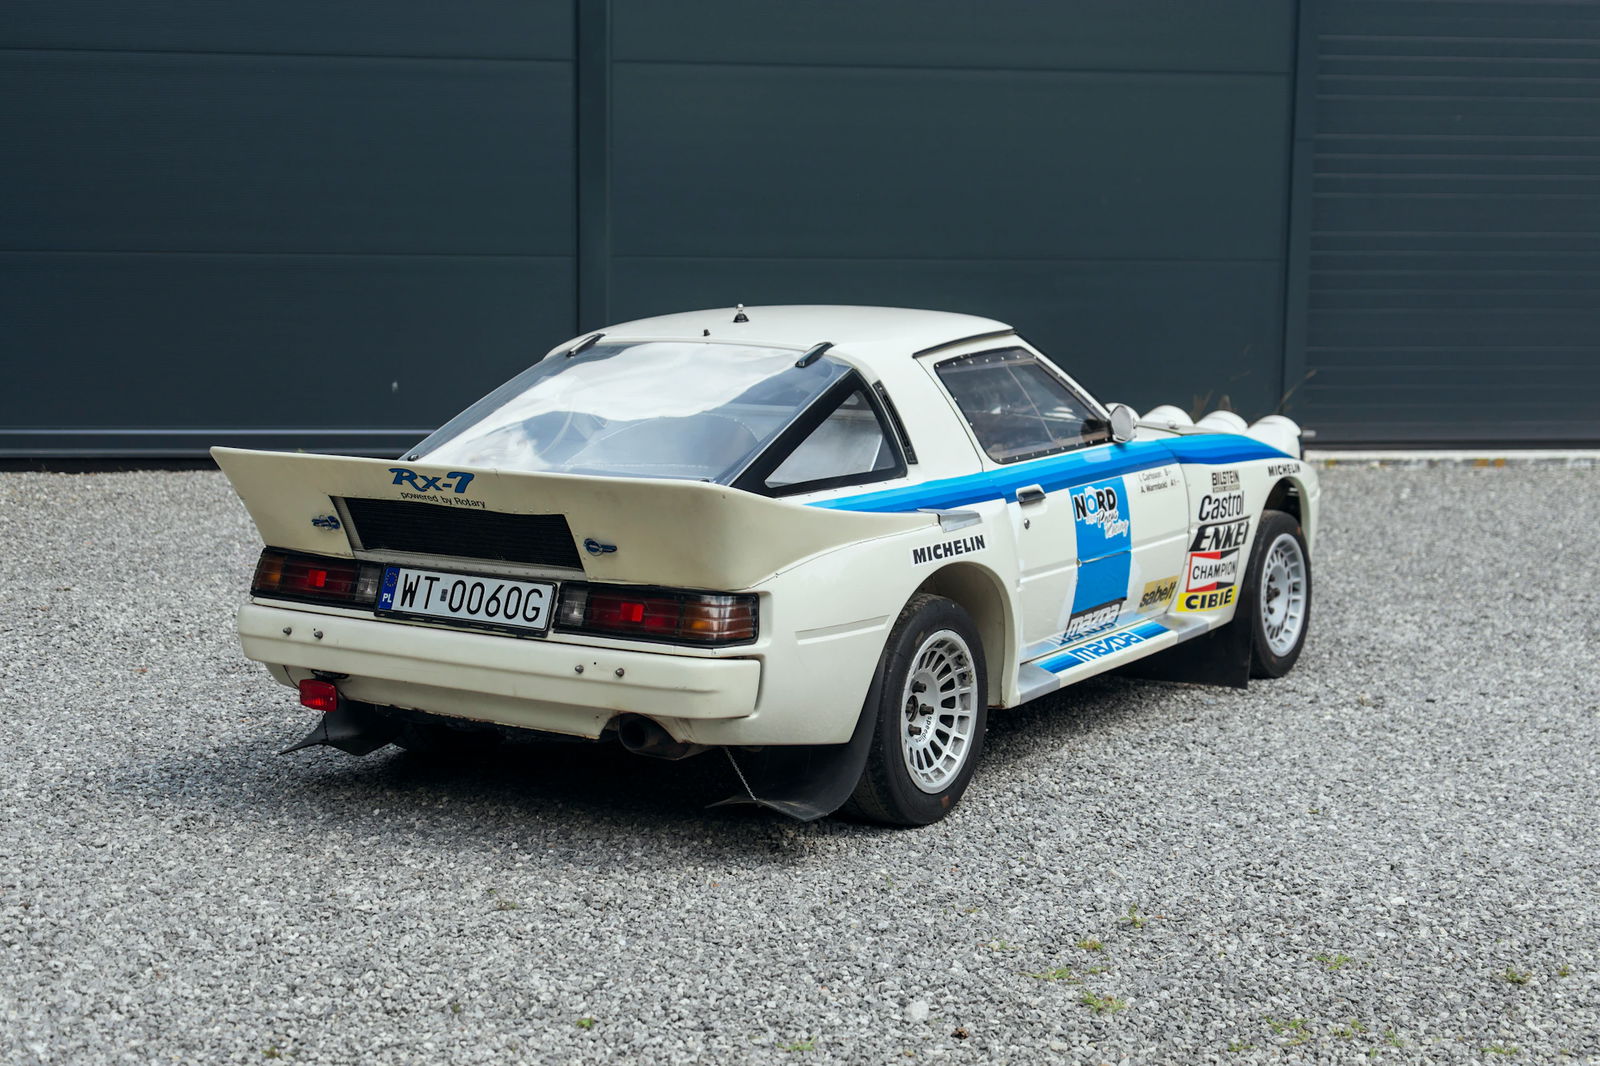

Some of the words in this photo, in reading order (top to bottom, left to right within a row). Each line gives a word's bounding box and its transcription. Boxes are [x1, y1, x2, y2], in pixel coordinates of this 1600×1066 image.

[1211, 469, 1240, 486] BILSTEIN
[1267, 463, 1301, 477] MICHELIN
[400, 492, 439, 503] powered
[440, 496, 452, 506] by
[453, 497, 486, 509] Rotary
[1073, 487, 1117, 519] NORD
[1198, 490, 1245, 522] Castrol
[1188, 519, 1250, 552] ENKEI
[912, 534, 986, 565] MICHELIN
[1192, 561, 1237, 580] CHAMPION
[382, 592, 392, 604] PL
[400, 573, 441, 609] WT
[448, 579, 544, 622] 0060G
